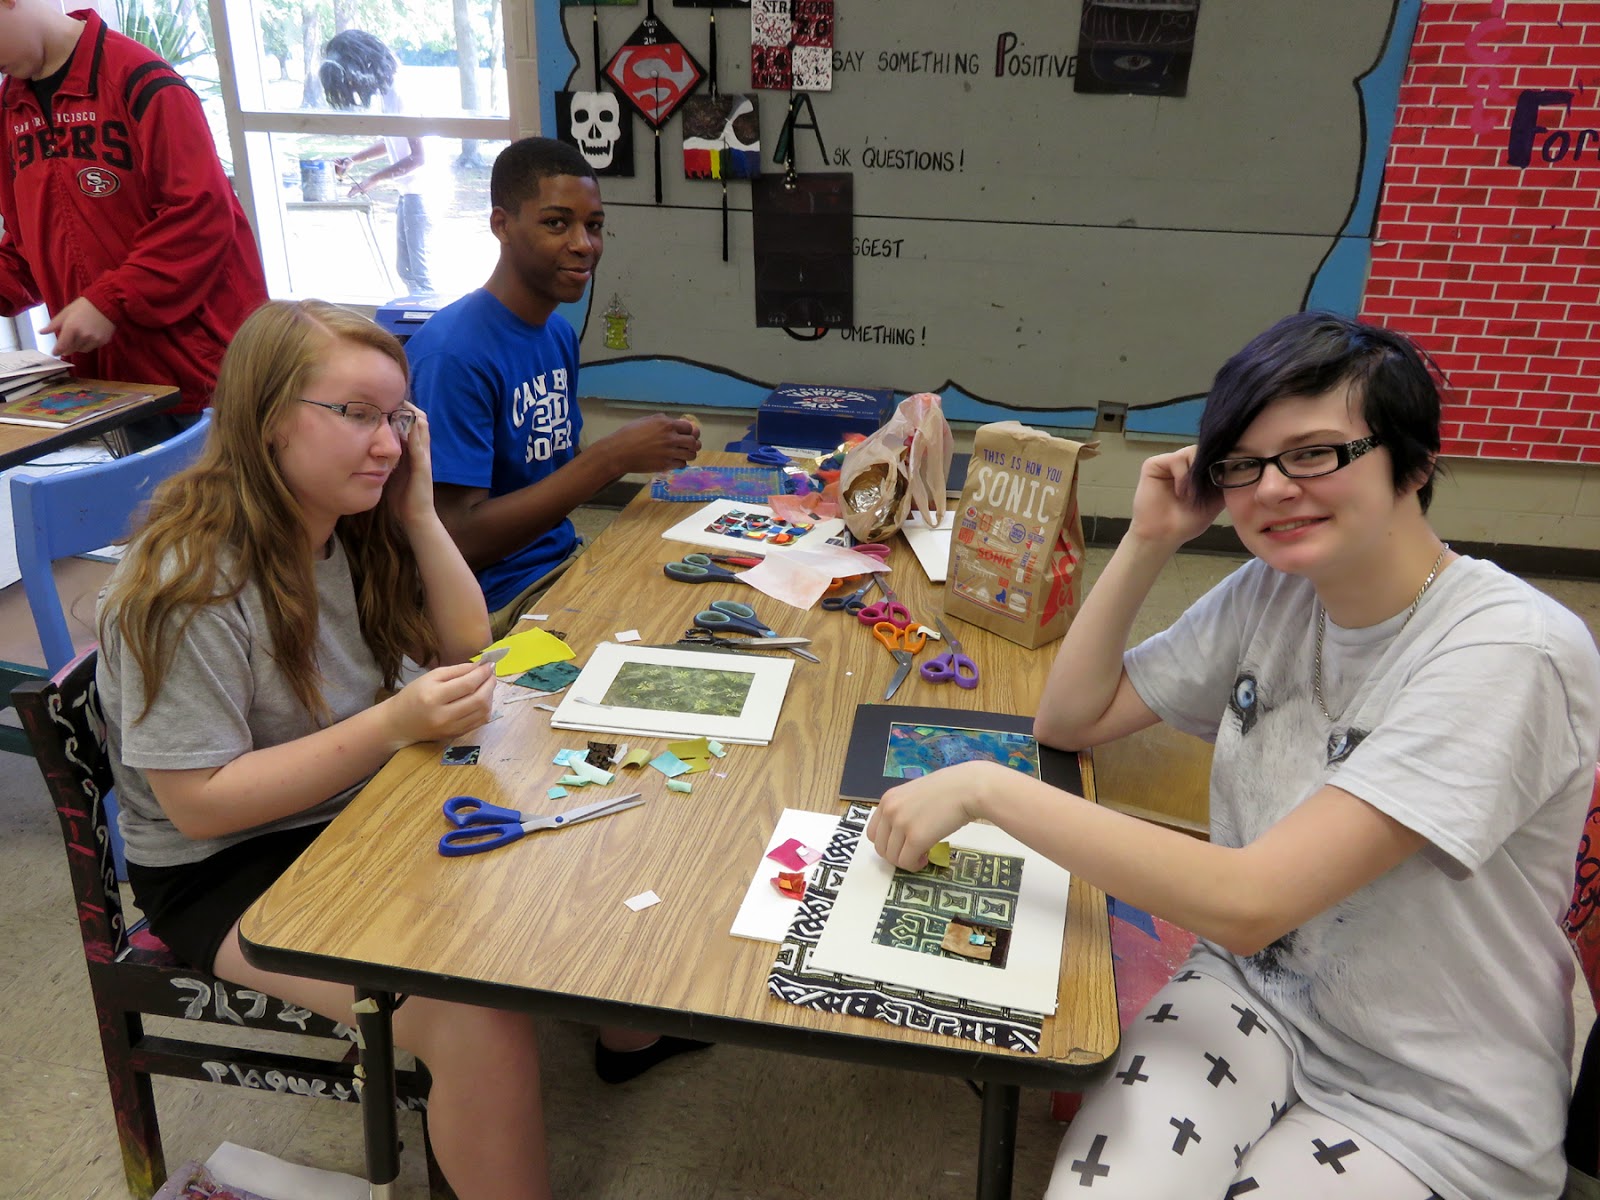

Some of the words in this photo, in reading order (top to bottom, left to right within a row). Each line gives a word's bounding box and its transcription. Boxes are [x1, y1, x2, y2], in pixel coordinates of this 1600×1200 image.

[832, 51, 864, 72] SAY
[878, 51, 979, 74] SOMETHING
[773, 93, 851, 167] ASK
[1507, 88, 1600, 169] For
[984, 449, 1006, 466] THIS
[1011, 456, 1022, 470] IS
[1025, 460, 1043, 476] HOW
[1046, 466, 1063, 483] YOU
[972, 466, 1055, 524] SONIC
[976, 547, 1015, 569] SONIC
